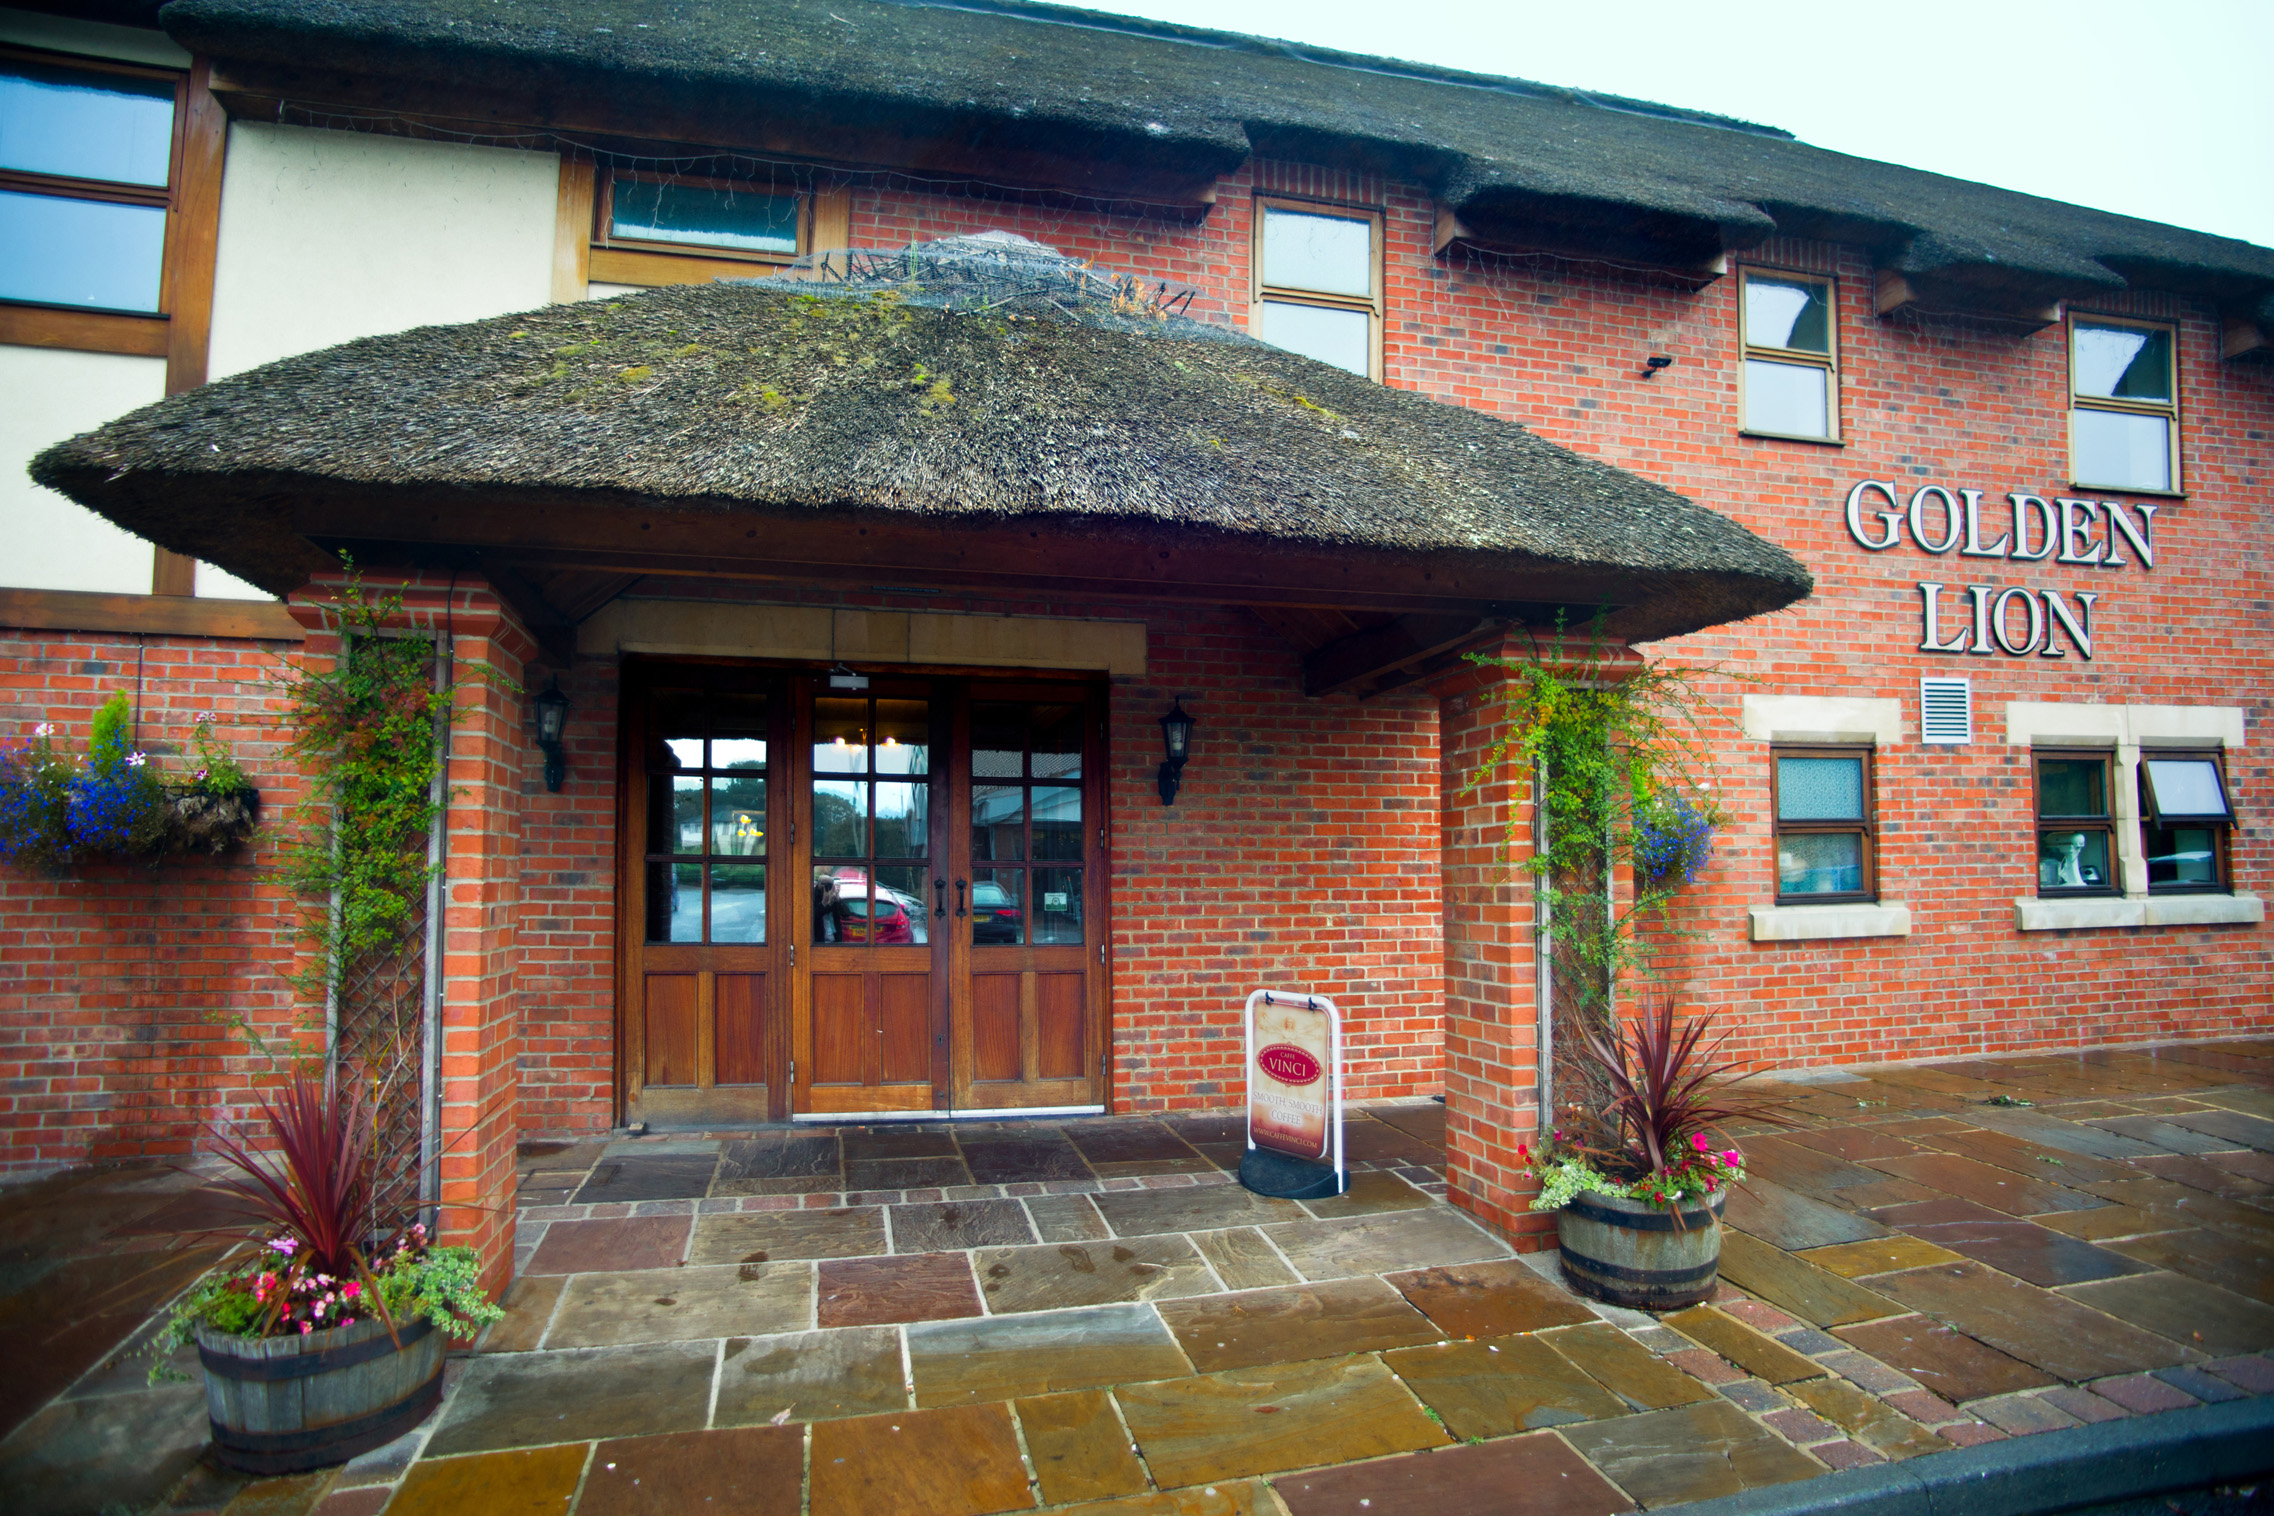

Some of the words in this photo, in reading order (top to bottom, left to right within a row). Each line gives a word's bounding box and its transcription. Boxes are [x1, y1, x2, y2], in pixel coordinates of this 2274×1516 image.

[1846, 479, 2158, 569] GOLDEN
[1918, 582, 2098, 659] LION
[1269, 1057, 1306, 1077] VINCI
[1253, 1091, 1287, 1108] SMOOTH,
[1288, 1099, 1323, 1115] SMOOTH
[1271, 1109, 1301, 1125] COFFEE
[1253, 1126, 1318, 1149] WWW.CAFFEVINCI.COM
